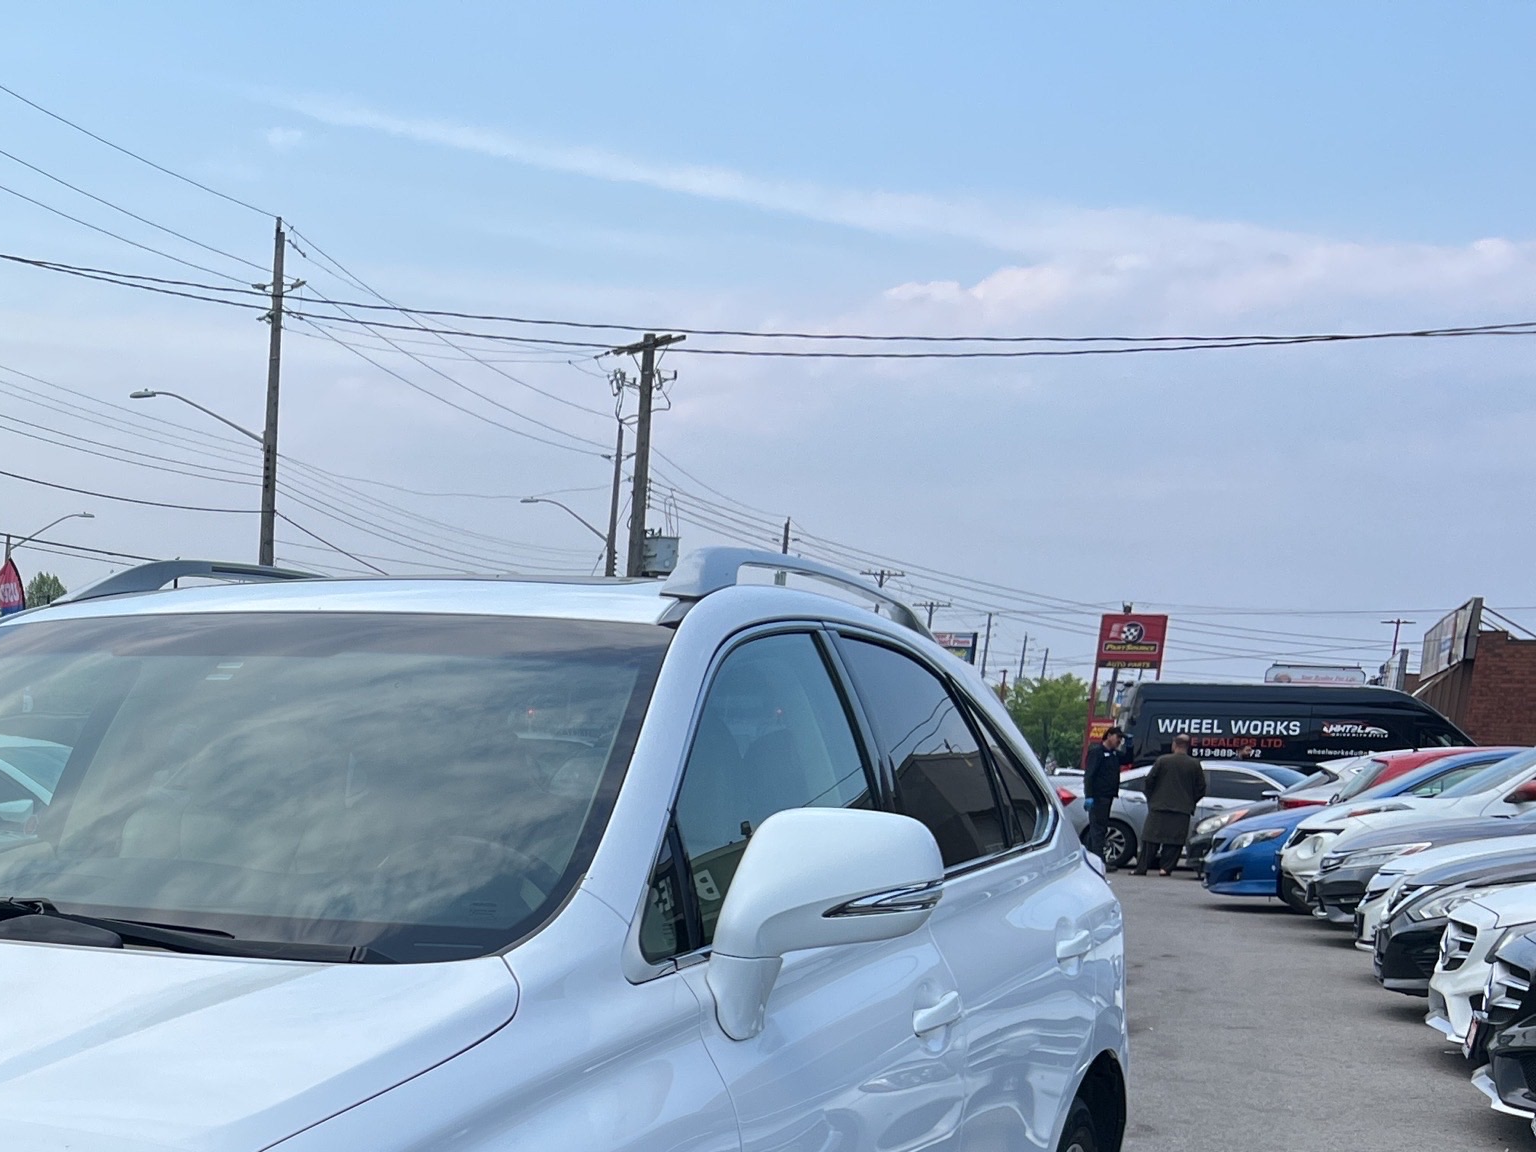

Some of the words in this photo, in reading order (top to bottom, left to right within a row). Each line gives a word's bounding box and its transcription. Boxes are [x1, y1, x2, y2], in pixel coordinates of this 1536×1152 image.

[1157, 718, 1223, 734] WHEEL
[1230, 719, 1301, 736] WORKS
[1202, 737, 1257, 748] DEALERS
